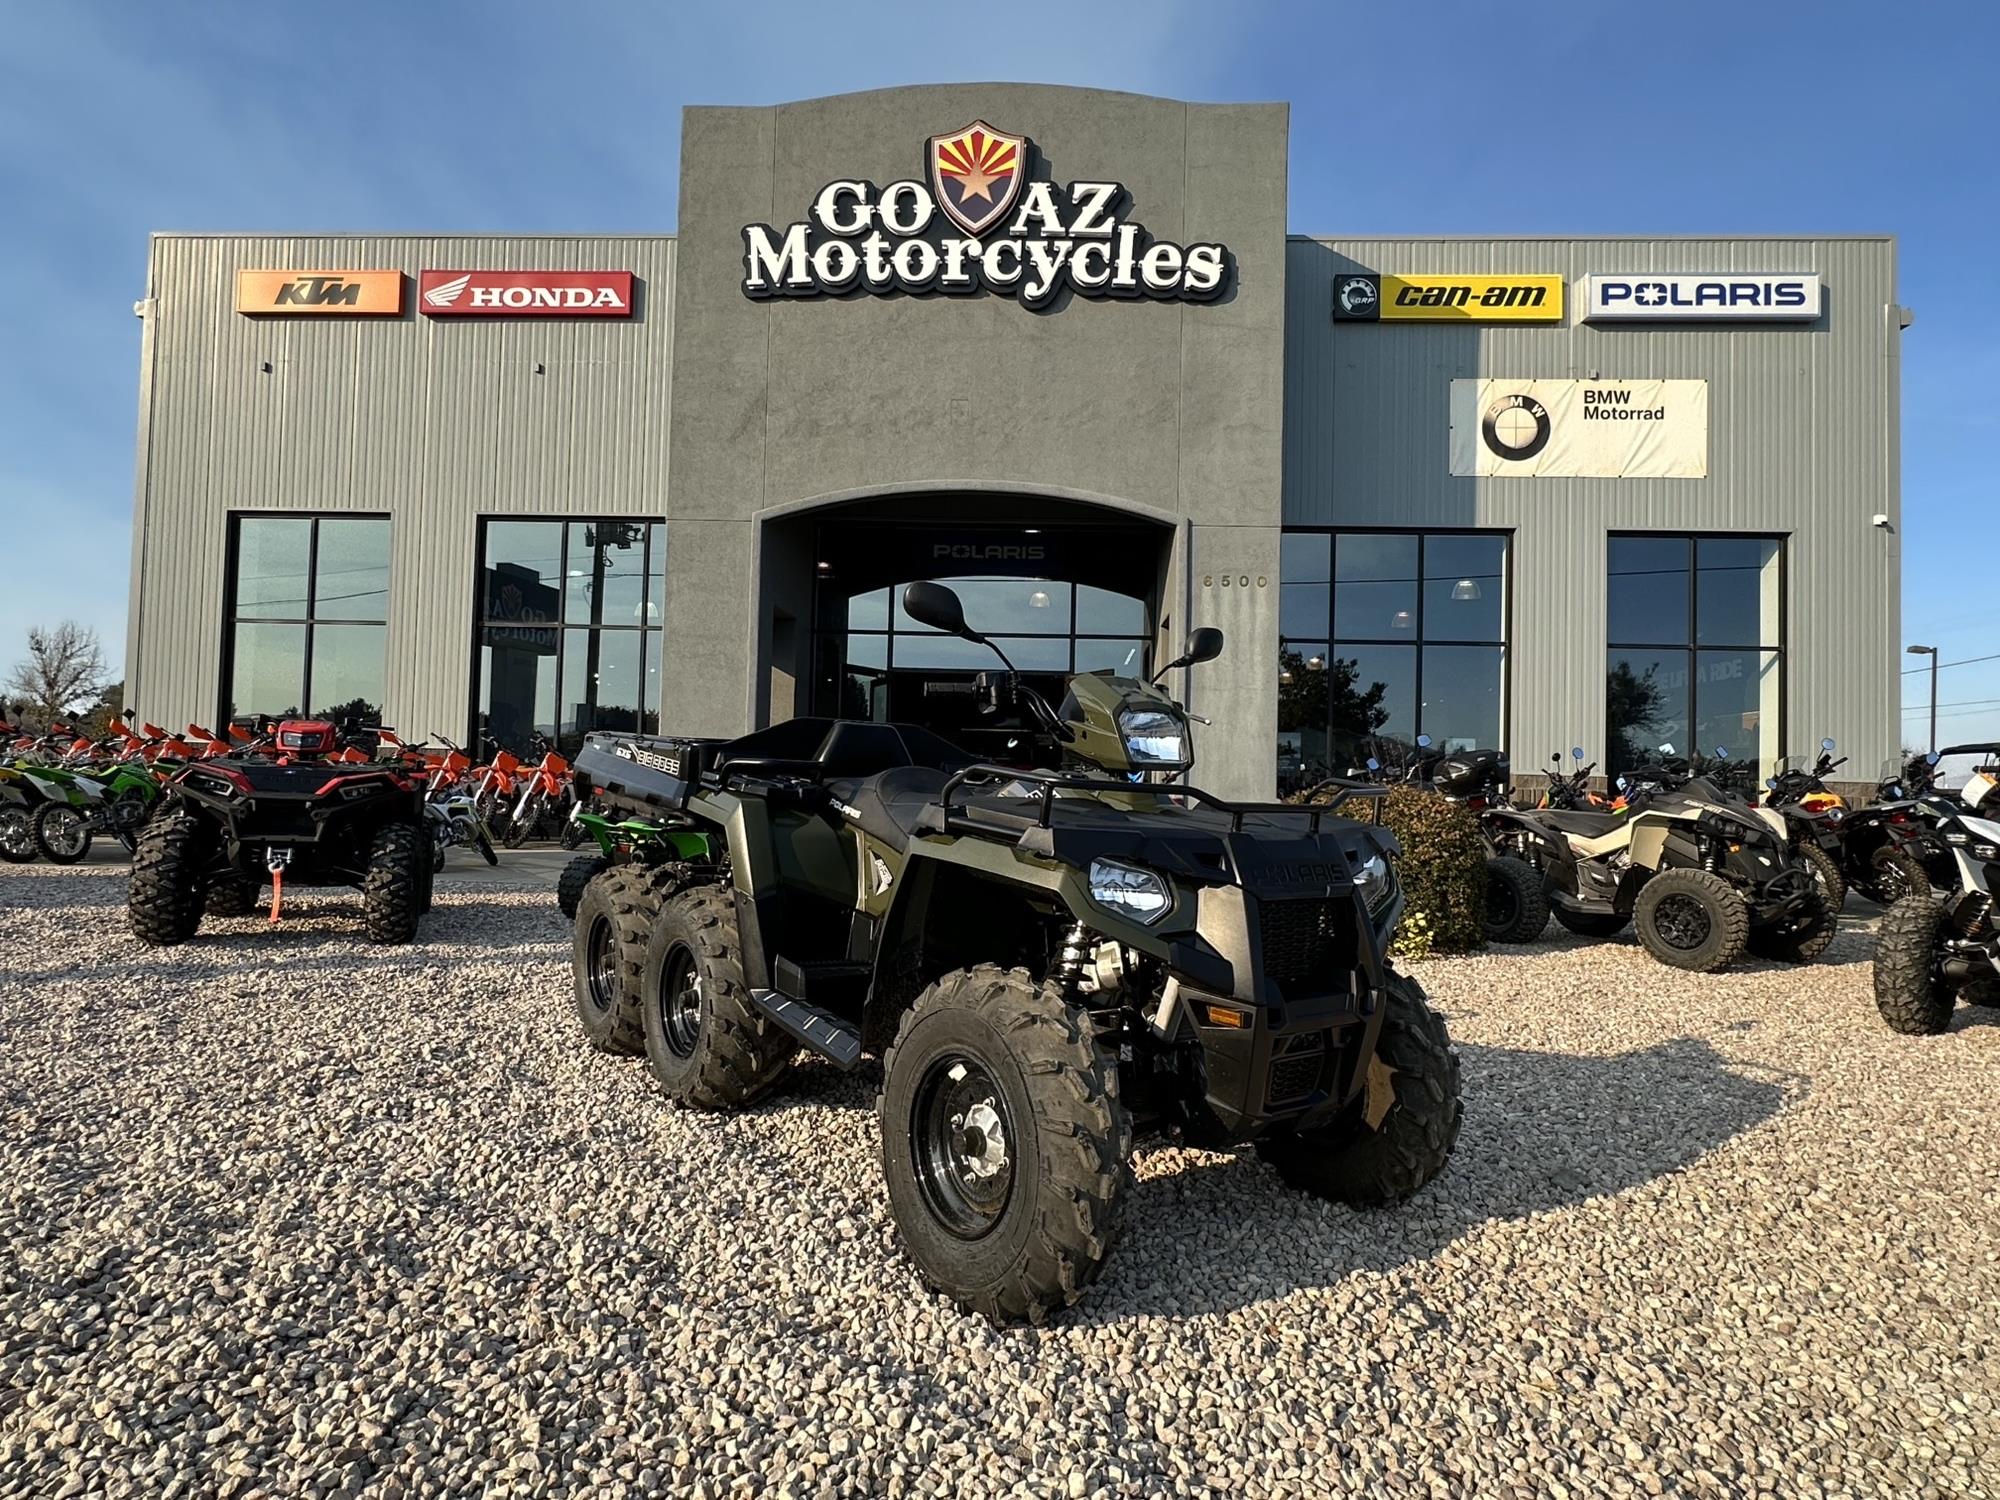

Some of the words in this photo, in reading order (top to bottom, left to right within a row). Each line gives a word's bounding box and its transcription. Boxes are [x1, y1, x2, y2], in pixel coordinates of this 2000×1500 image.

[814, 181, 937, 236] GO
[1009, 181, 1118, 237] AZ
[745, 225, 1225, 301] Motorcycles
[274, 277, 361, 305] KTM
[470, 287, 625, 307] HONDA
[1395, 286, 1547, 307] can-am
[1601, 283, 1806, 306] POLARIS
[1489, 396, 1546, 418] BMW
[1584, 390, 1631, 404] BMW
[1583, 406, 1664, 420] Motorrad
[933, 544, 1045, 559] POLARIS
[1203, 575, 1267, 588] 6500
[828, 798, 862, 819] POLARIS
